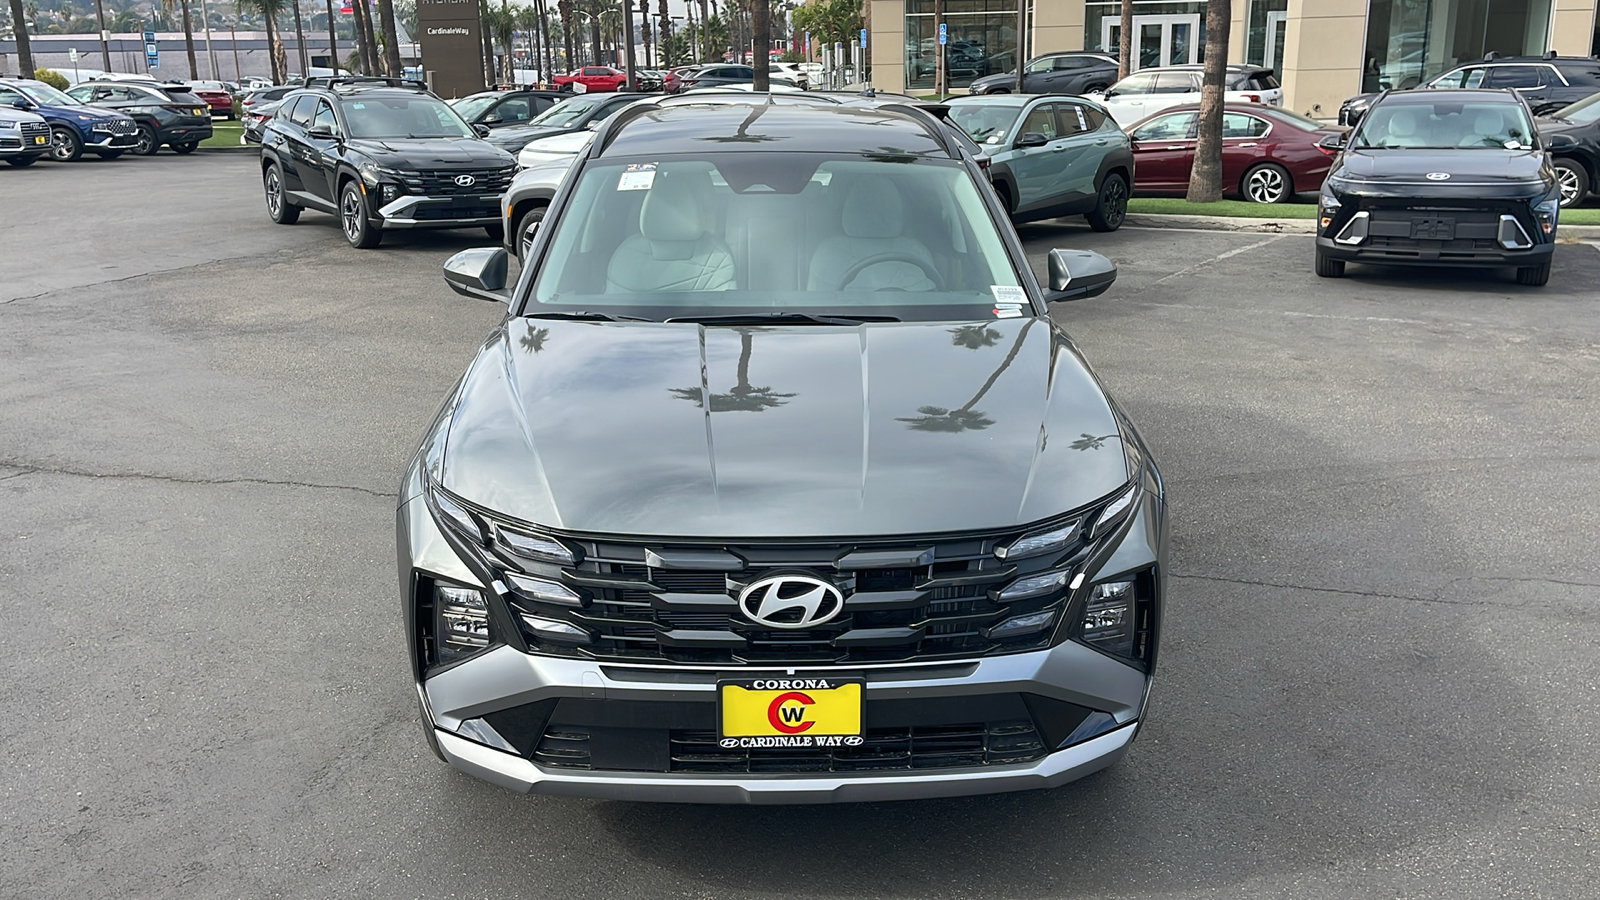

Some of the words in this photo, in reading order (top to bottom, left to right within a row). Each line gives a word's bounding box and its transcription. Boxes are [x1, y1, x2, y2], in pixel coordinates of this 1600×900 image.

[427, 28, 469, 36] CardinaleWay
[753, 679, 830, 689] CORONA
[740, 736, 813, 747] CARDINALE
[814, 736, 844, 746] WAY
